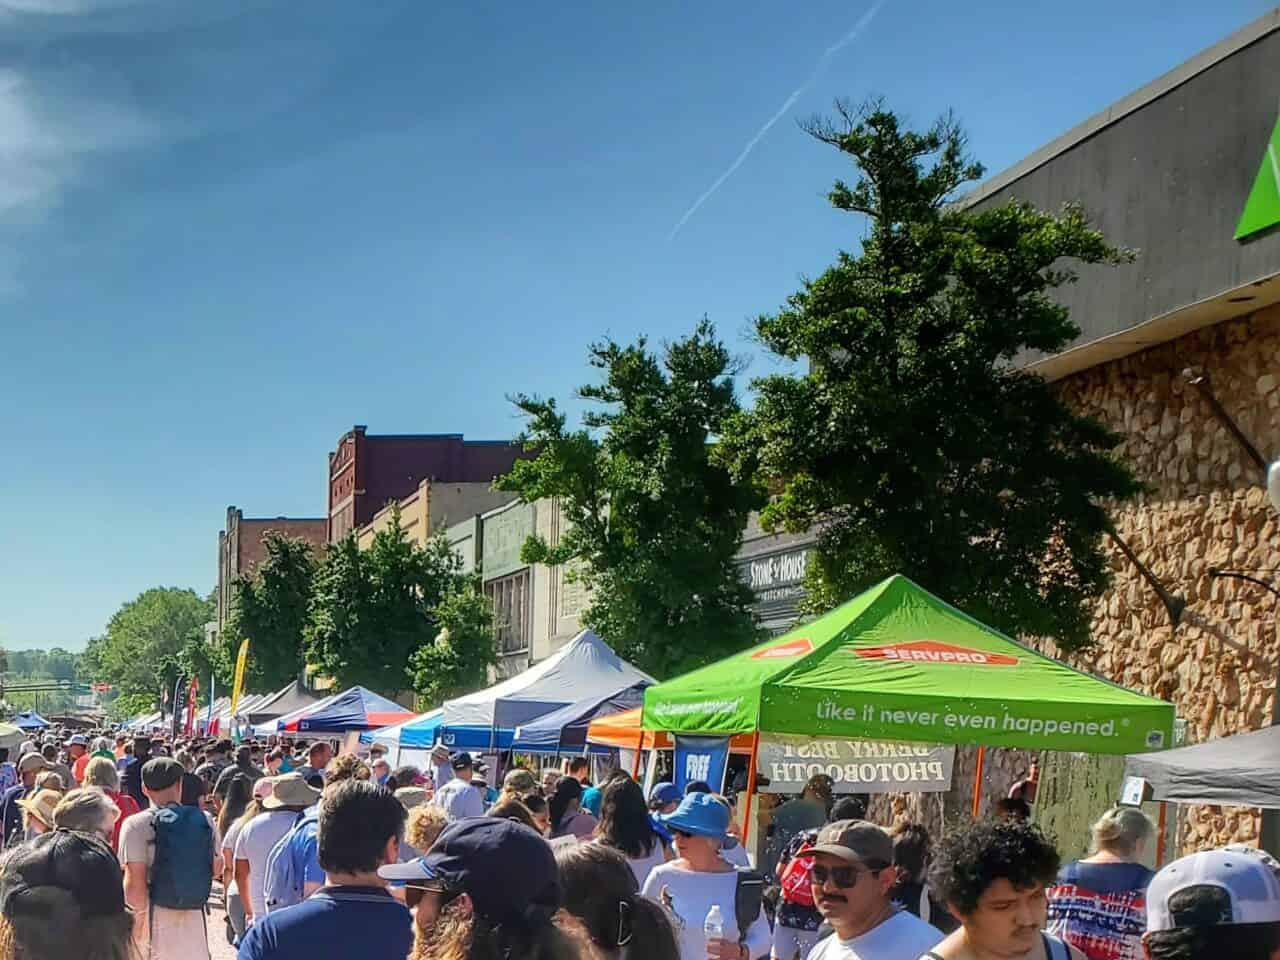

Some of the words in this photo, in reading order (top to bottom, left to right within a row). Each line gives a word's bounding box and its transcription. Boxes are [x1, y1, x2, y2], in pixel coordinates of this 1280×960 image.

[750, 559, 773, 588] STONE
[780, 550, 807, 582] HOUSE
[883, 648, 988, 663] SERVPRO
[816, 702, 857, 721] Like
[862, 704, 875, 721] it
[880, 709, 938, 726] never
[943, 712, 996, 729] even
[1002, 713, 1119, 736] happened.
